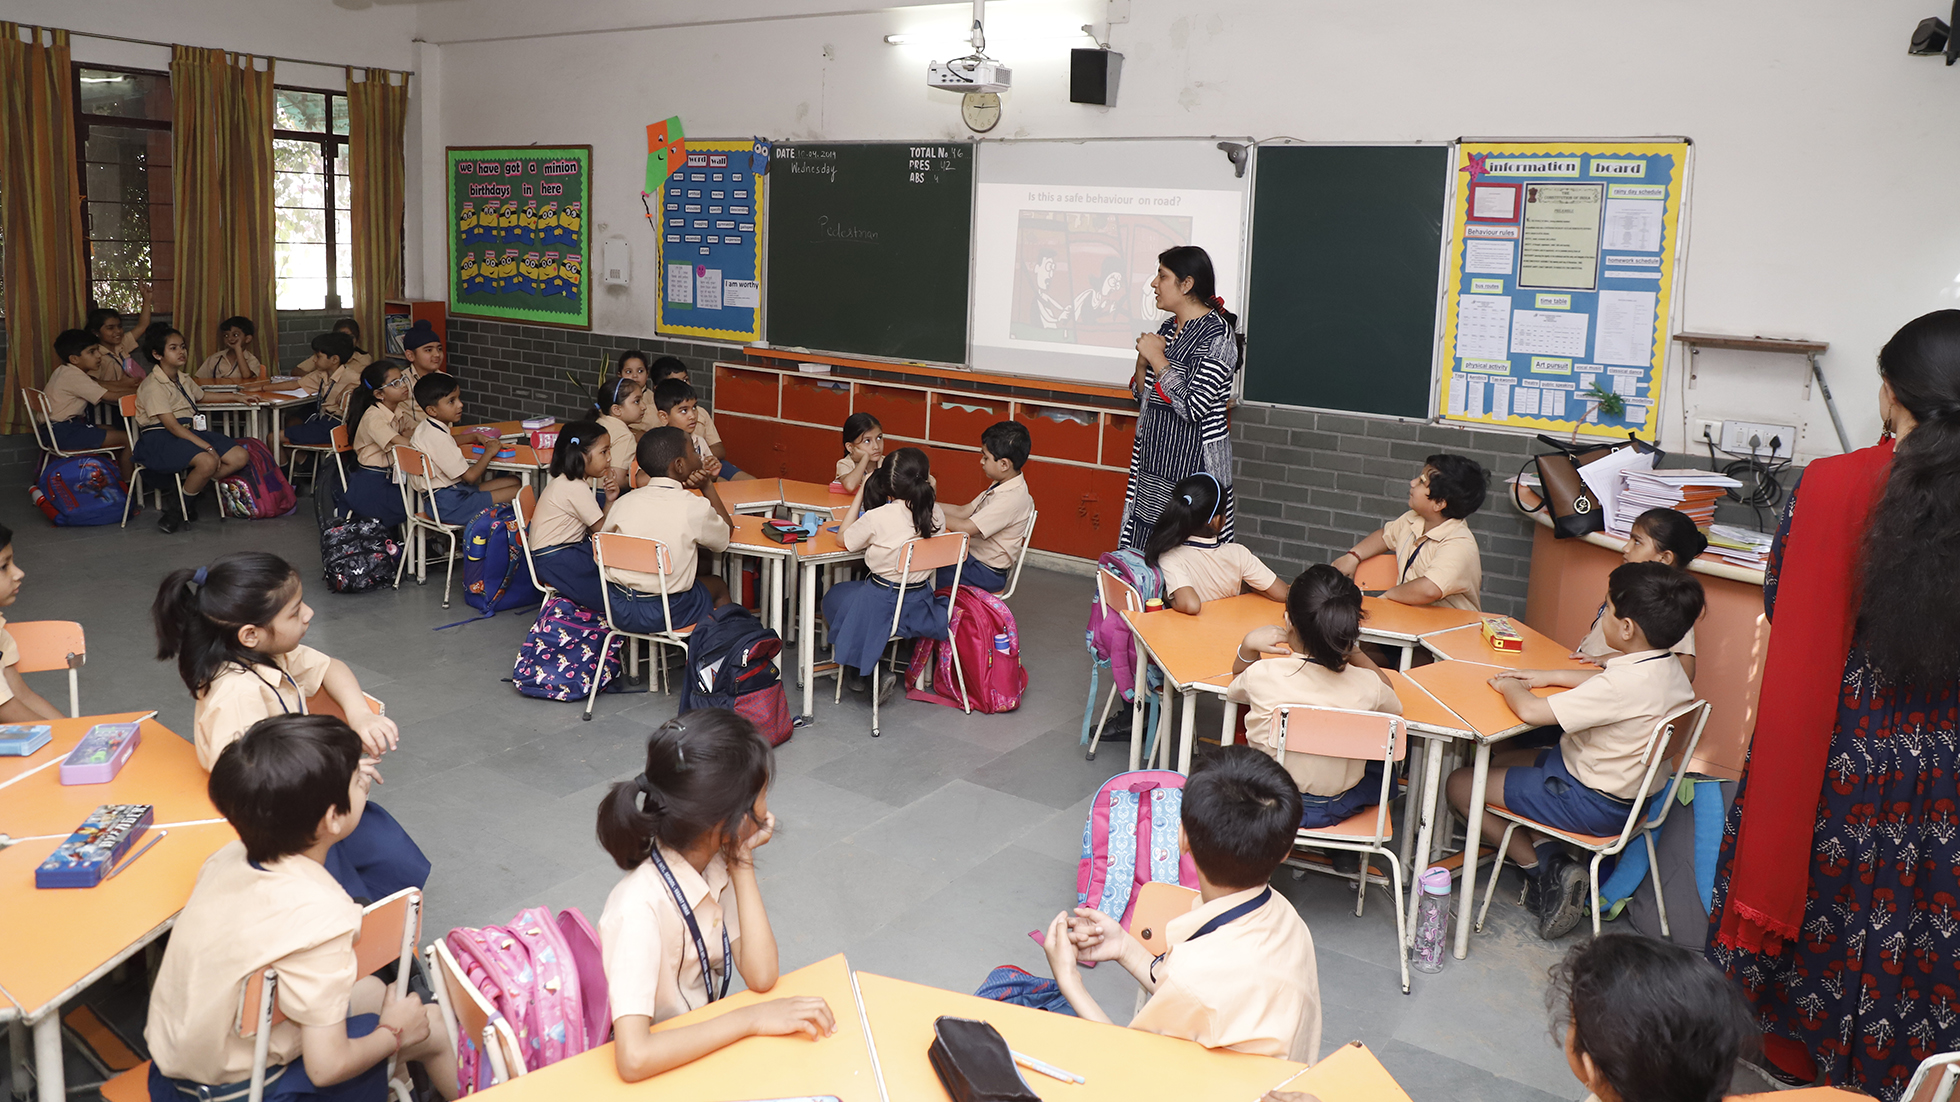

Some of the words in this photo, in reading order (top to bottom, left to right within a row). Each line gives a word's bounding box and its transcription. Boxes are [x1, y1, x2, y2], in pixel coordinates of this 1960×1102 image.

[776, 148, 795, 158] DATE
[910, 146, 936, 158] TOTAL
[460, 163, 473, 173] we
[478, 162, 500, 174] have
[505, 162, 520, 174] got
[530, 164, 536, 173] a
[544, 162, 577, 174] minion
[909, 160, 930, 171] PRES
[1490, 162, 1576, 173] information
[1595, 162, 1641, 174] board
[790, 161, 838, 183] Wednesday
[910, 172, 925, 184] ABS
[470, 184, 510, 198] birthdays
[523, 184, 532, 195] in
[541, 182, 562, 194] here
[1028, 192, 1036, 200] Is
[1038, 192, 1055, 202] this
[1064, 193, 1084, 203] safe
[1086, 193, 1134, 205] behaviour
[1153, 196, 1182, 206] road?
[740, 281, 759, 290] worthy
[1488, 363, 1508, 371] activity
